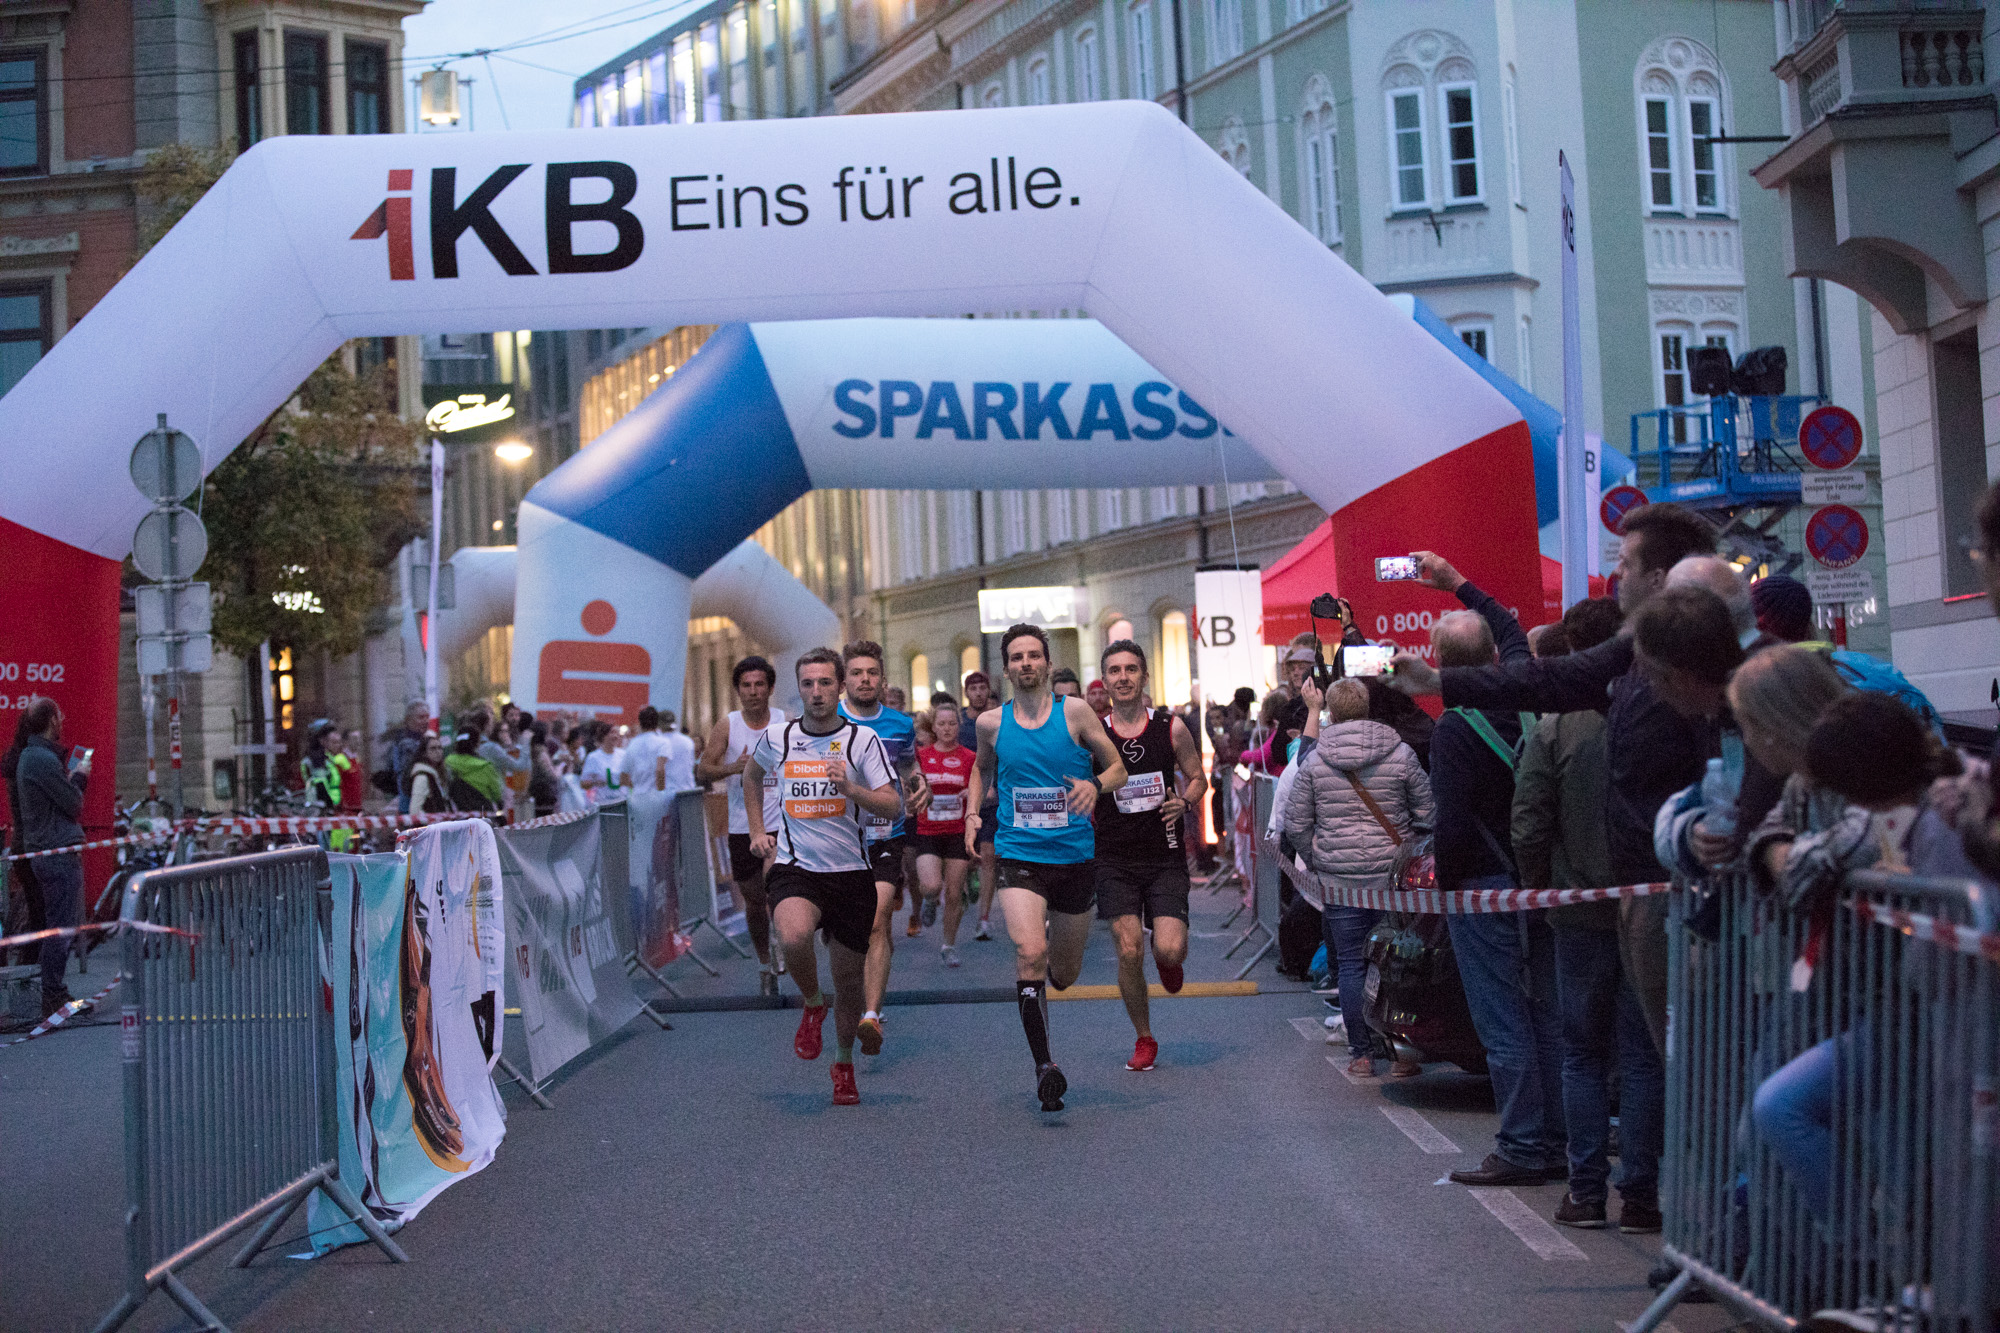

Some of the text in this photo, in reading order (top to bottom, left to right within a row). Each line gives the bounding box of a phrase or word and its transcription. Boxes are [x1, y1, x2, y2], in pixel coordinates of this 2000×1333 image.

[670, 173, 809, 232] Eins
[832, 165, 924, 223] für
[948, 156, 1080, 216] alle.
[831, 378, 1237, 442] SPARKASS
[1819, 554, 1859, 568] ANFANG
[1376, 615, 1388, 635] 0
[1393, 611, 1433, 633] 800
[26, 663, 65, 682] 502
[793, 764, 828, 773] bibch
[791, 781, 839, 797] 66173
[1015, 792, 1057, 800] SPARKASSE
[1142, 786, 1160, 795] 1132
[794, 803, 836, 813] bibchip
[1043, 802, 1063, 811] 1065
